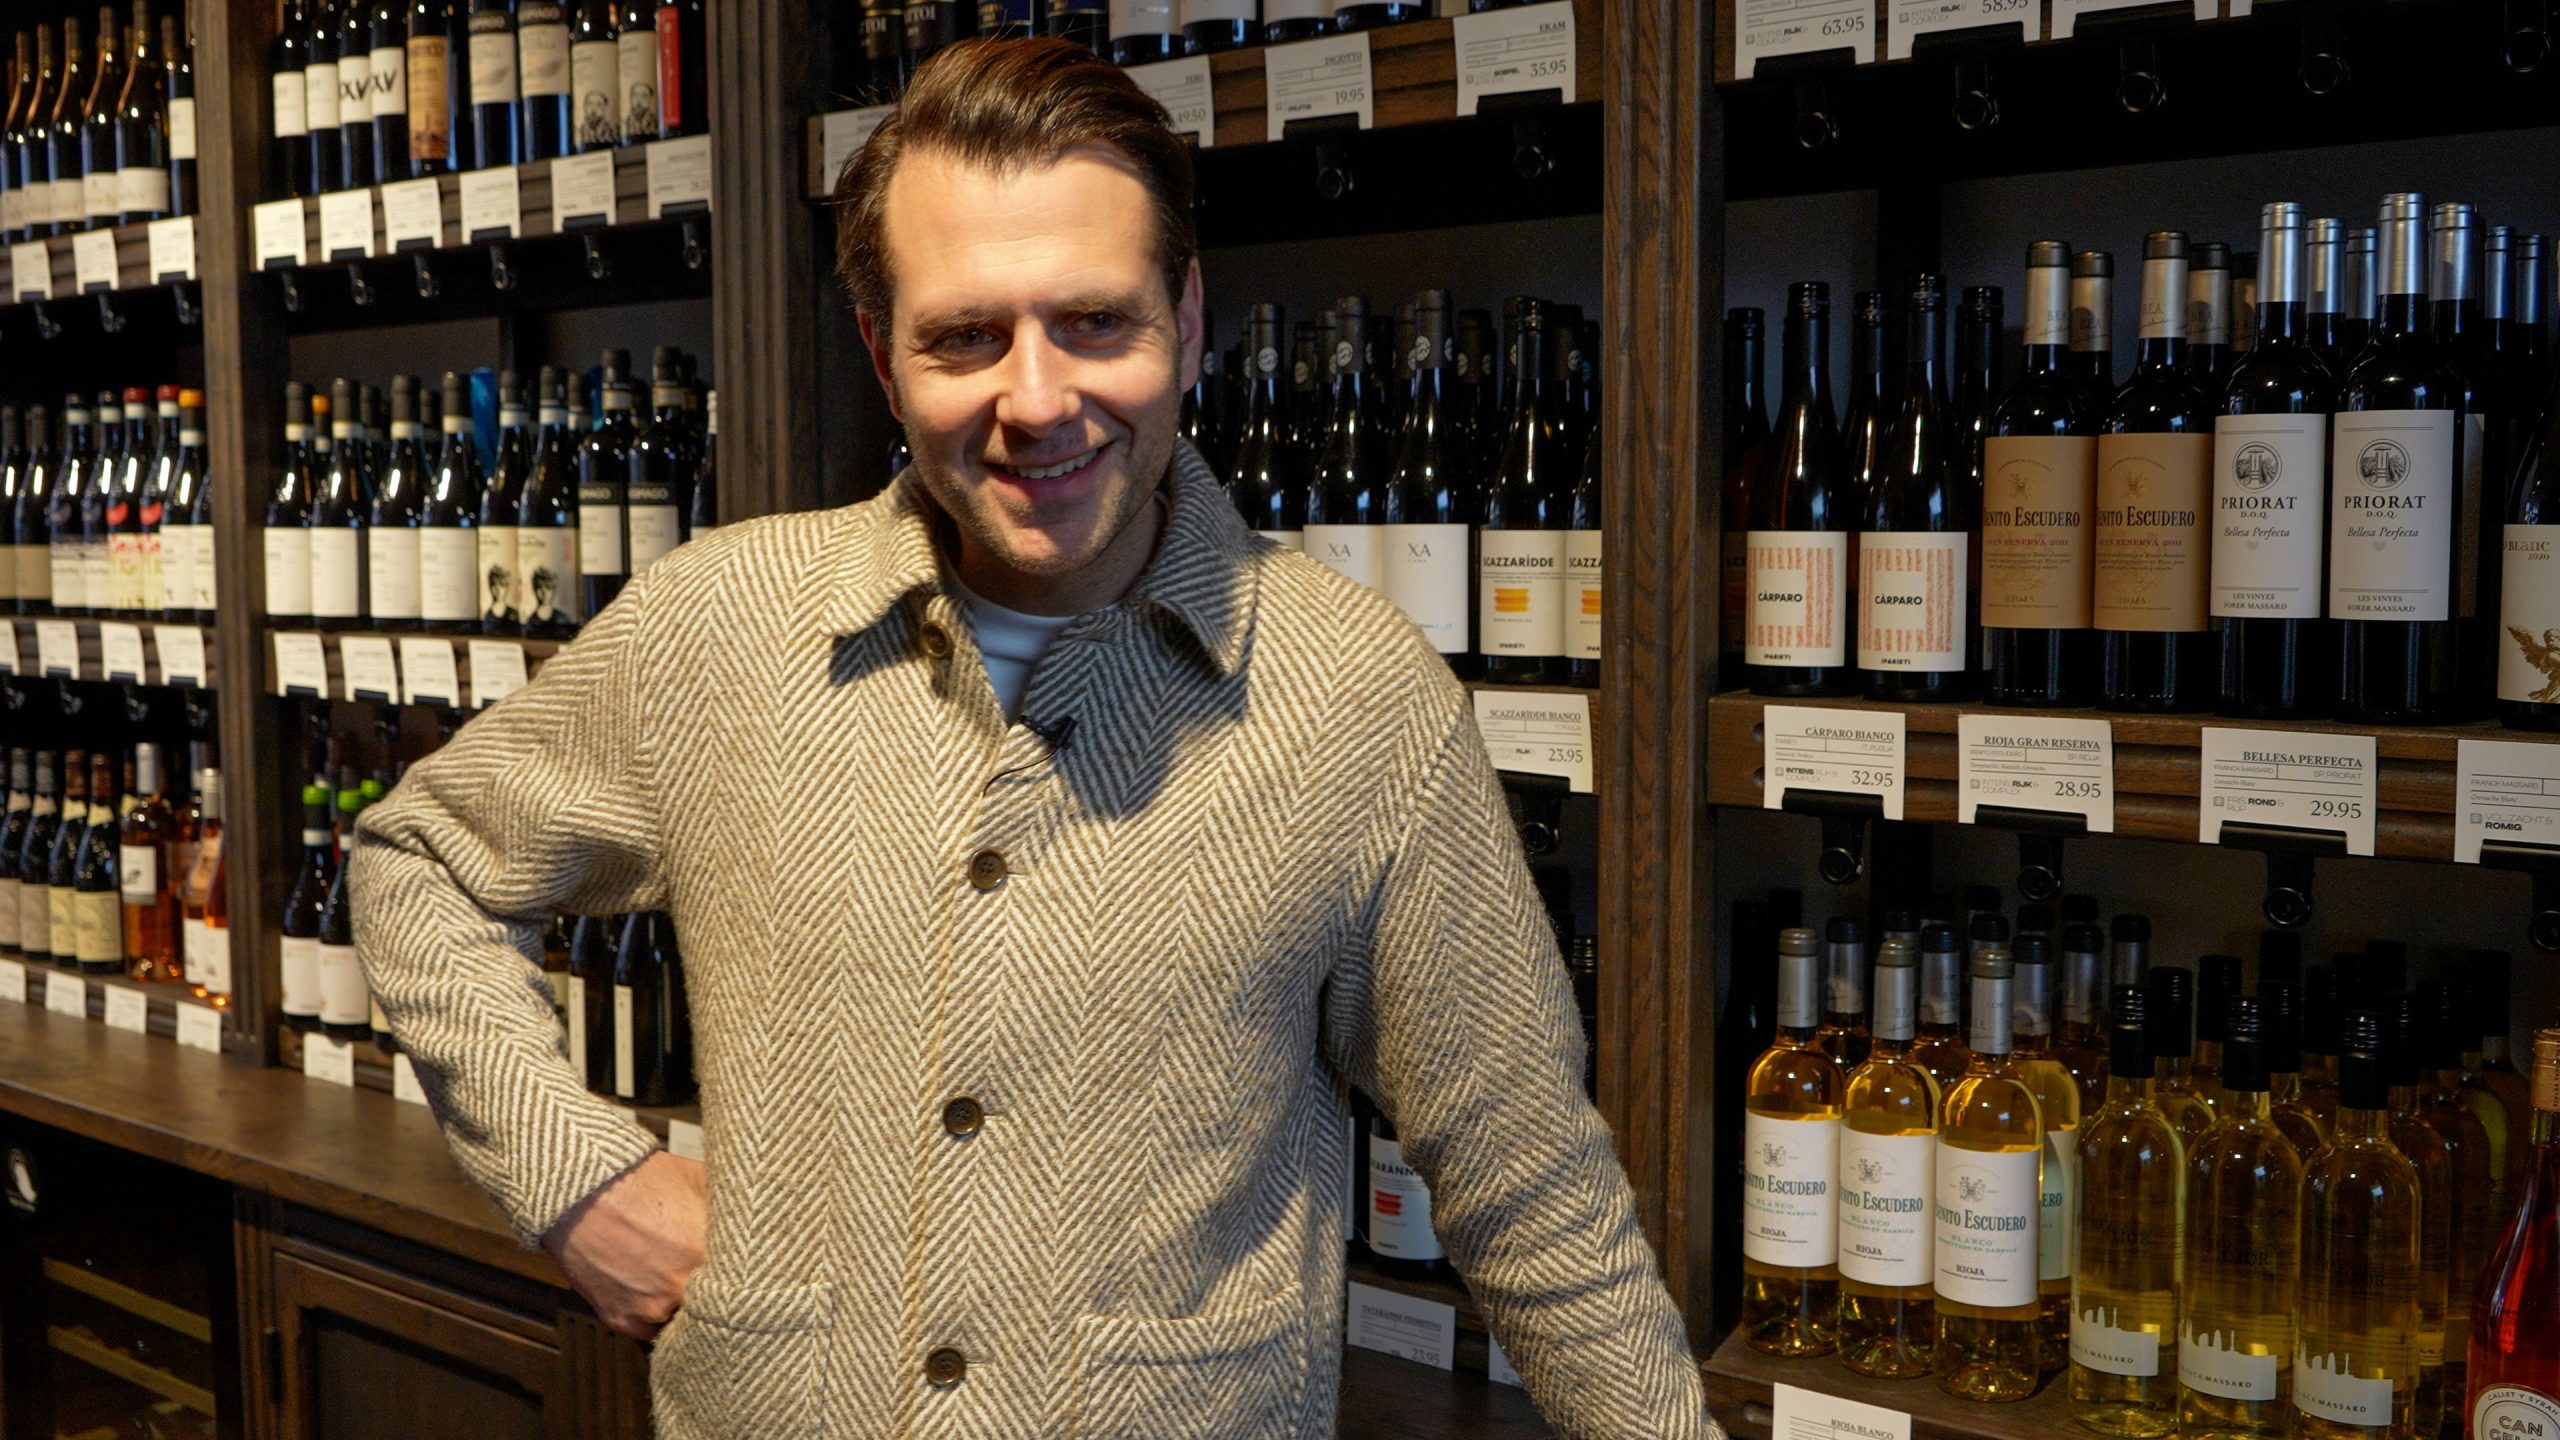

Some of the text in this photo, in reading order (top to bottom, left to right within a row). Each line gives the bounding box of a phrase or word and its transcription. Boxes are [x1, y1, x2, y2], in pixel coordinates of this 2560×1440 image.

[1539, 20, 1567, 33] EKAM
[1821, 15, 1864, 36] 63.95
[1530, 59, 1566, 78] 35.95
[1335, 87, 1365, 105] 19.95
[2221, 496, 2298, 510] PRIORAT
[2344, 495, 2427, 510] PRIORAT
[2015, 506, 2080, 527] ESCUDERO
[2127, 505, 2195, 527] ESCUDERO
[2224, 527, 2290, 540] Bellesa Perfecta
[2347, 526, 2419, 540] Bellesa Perfecta
[1327, 543, 1351, 557] XA
[1407, 543, 1431, 557] XA
[2527, 553, 2550, 561] 2020
[1875, 594, 1923, 605] CÀRPARO
[2246, 593, 2275, 601] VINYES
[2358, 595, 2403, 603] LES VINYES
[2248, 602, 2287, 610] MASSARD
[2374, 605, 2416, 613] MASSARD
[1549, 711, 1582, 722] BIANCO
[1855, 731, 1895, 742] BIANCO
[1984, 736, 2100, 750] RIOJA GRAN RESERVA
[1549, 748, 1583, 764] 23.95
[2243, 751, 2362, 768] BELLESA PERFECTA
[1852, 770, 1894, 788] 32.95
[2012, 780, 2032, 788] RIJK
[2055, 781, 2102, 799] 28.95
[2248, 797, 2276, 807] ROND
[2310, 800, 2362, 820] 29.95
[2485, 821, 2522, 831] ROMIG
[1768, 1174, 1826, 1195] ESCUDERO
[1863, 1191, 1923, 1213] ESCUDERO
[1851, 1215, 1890, 1227] BLANCO
[1964, 1209, 2027, 1231] ESCUDERO
[1760, 1226, 1786, 1238] RIOJA
[1951, 1234, 1993, 1247] BLANCO
[1856, 1244, 1882, 1256] RIOJA
[1956, 1264, 1985, 1277] RIOJA
[1412, 1348, 1441, 1366] 23.95
[2090, 1350, 2135, 1364] MASSARD
[2205, 1375, 2252, 1389] MASSARD
[2318, 1399, 2367, 1413] MASSARD
[2487, 1391, 2560, 1416] CALLET Y SYRAH
[1831, 1418, 1895, 1440] RIOJA BLANCO
[2498, 1415, 2544, 1437] CAN
